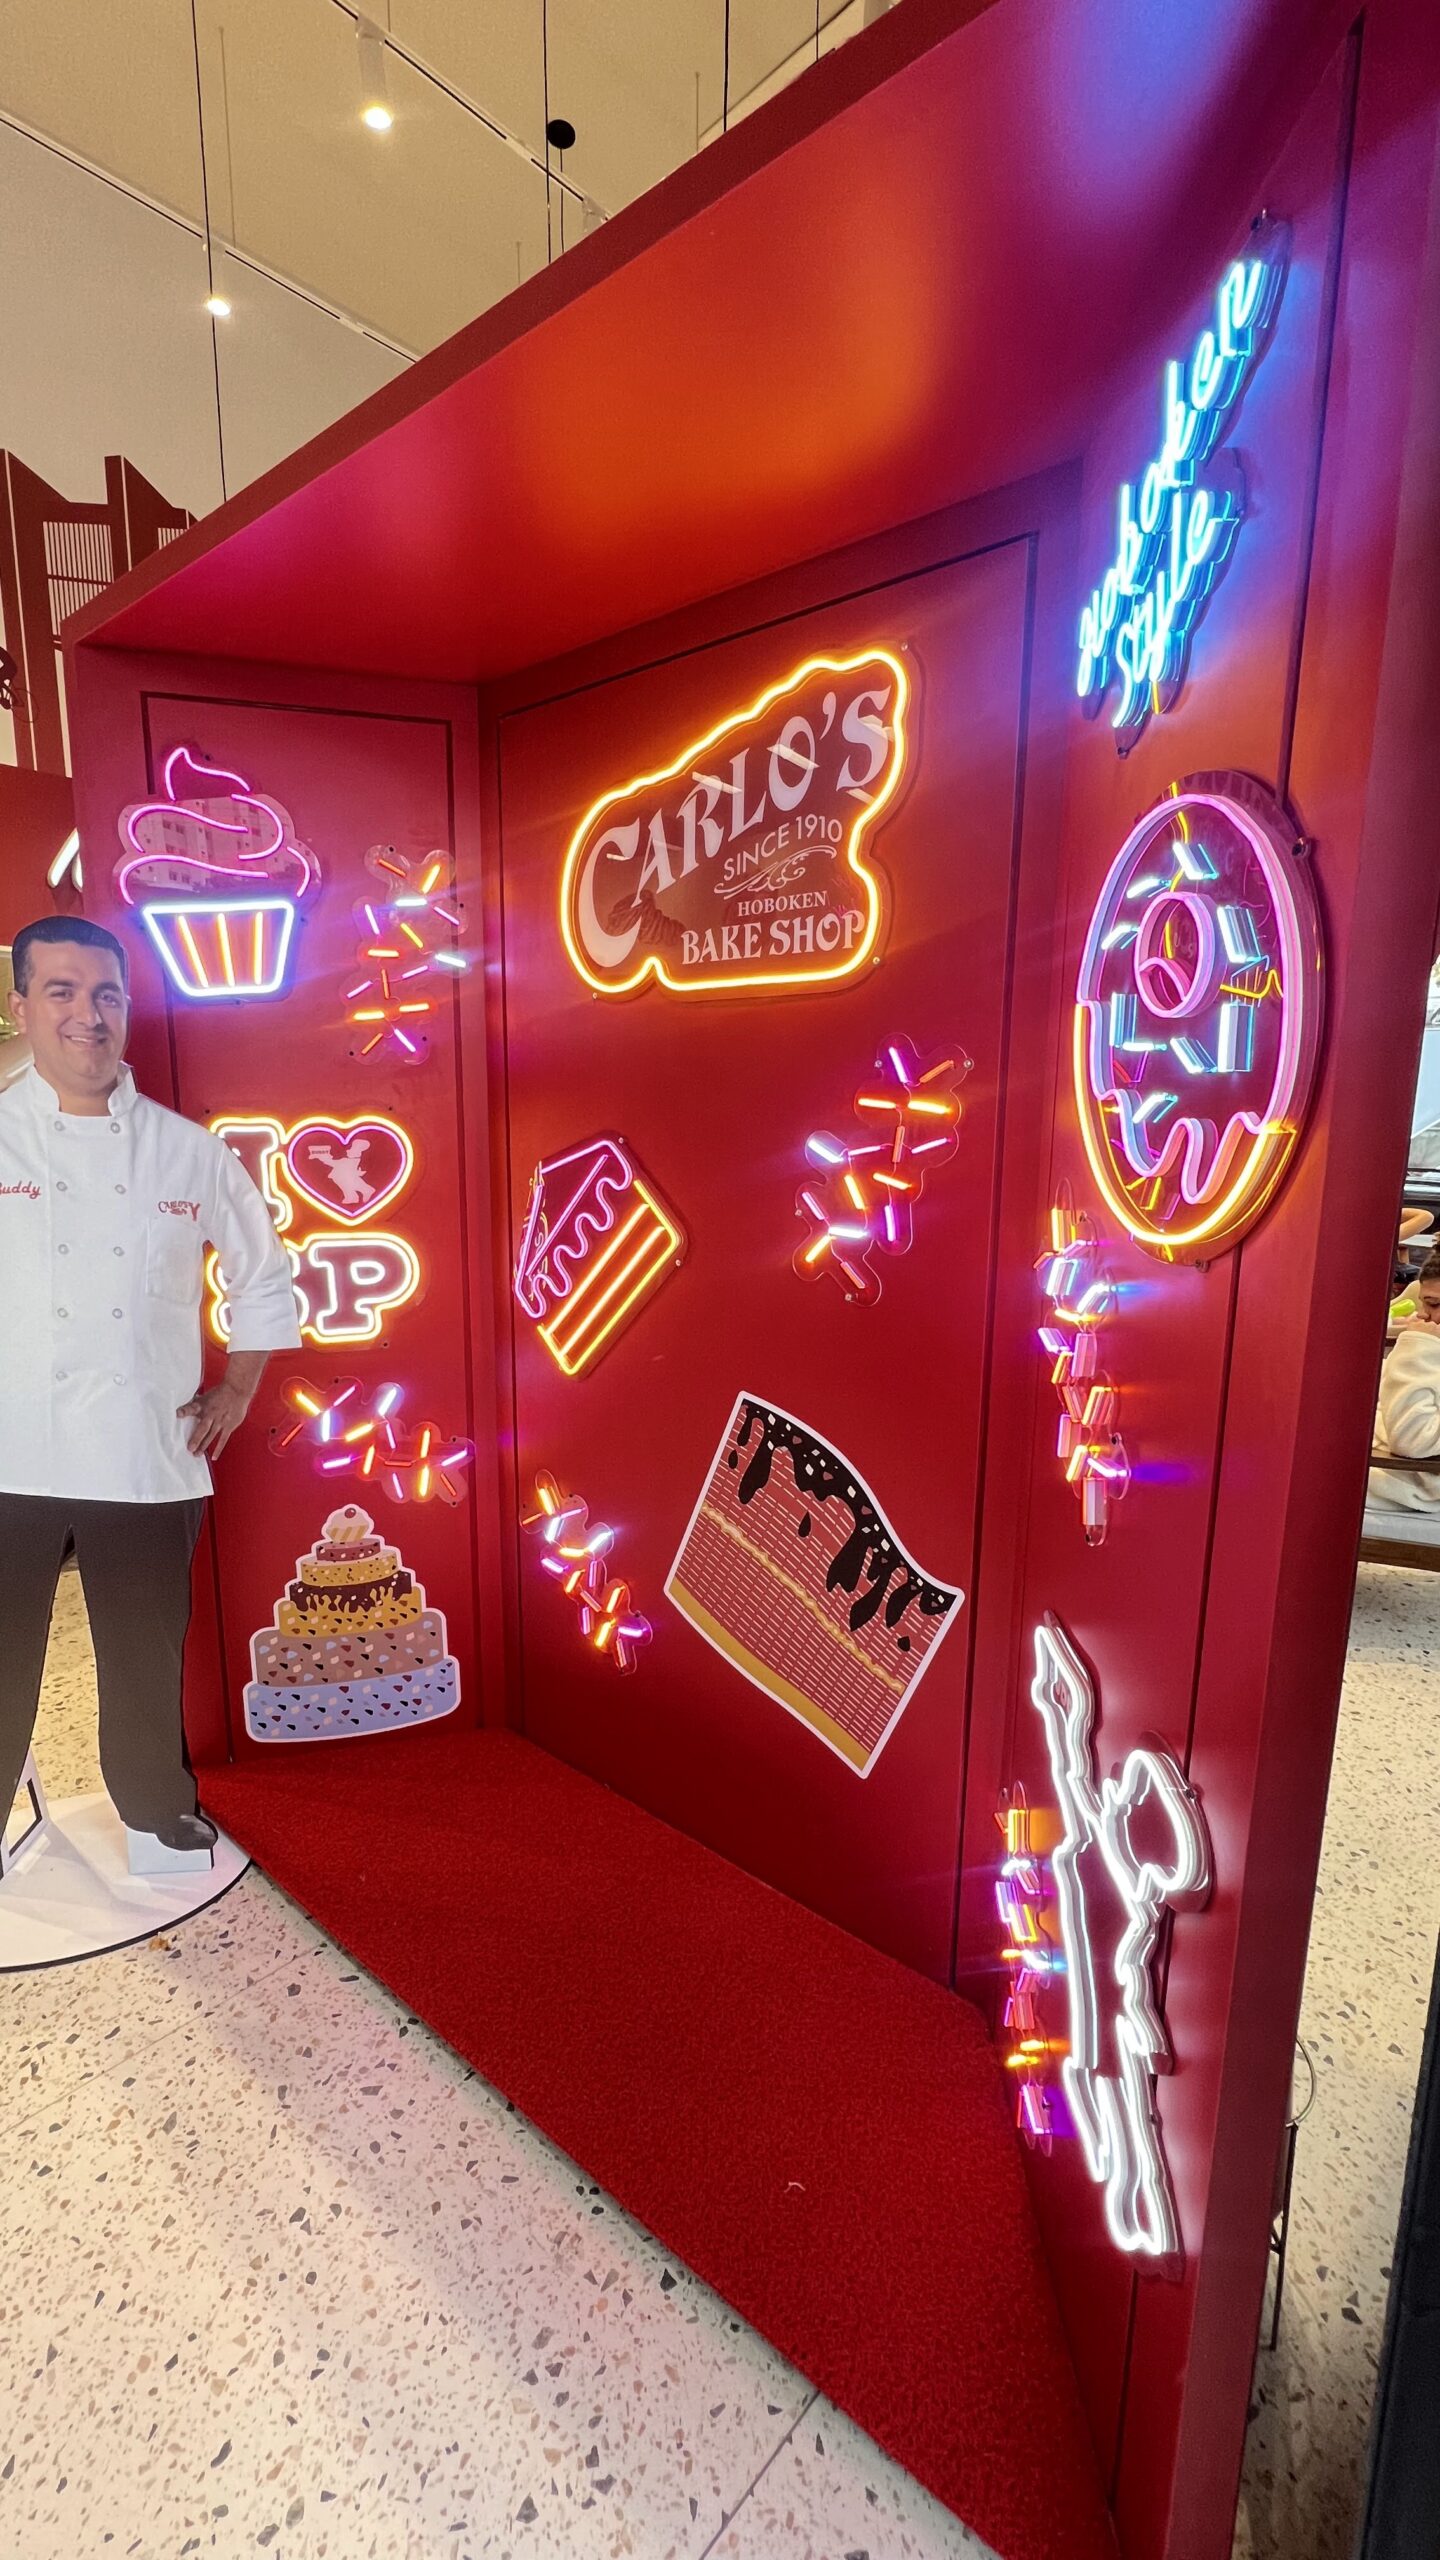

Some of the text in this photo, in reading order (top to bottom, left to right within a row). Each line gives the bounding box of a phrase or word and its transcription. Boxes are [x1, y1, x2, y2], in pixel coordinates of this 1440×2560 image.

[578, 685, 892, 968] CARLO'S
[722, 813, 843, 881] SINCE 1910
[737, 890, 827, 917] HOBOKEN
[680, 909, 865, 965] BAKE SHOP
